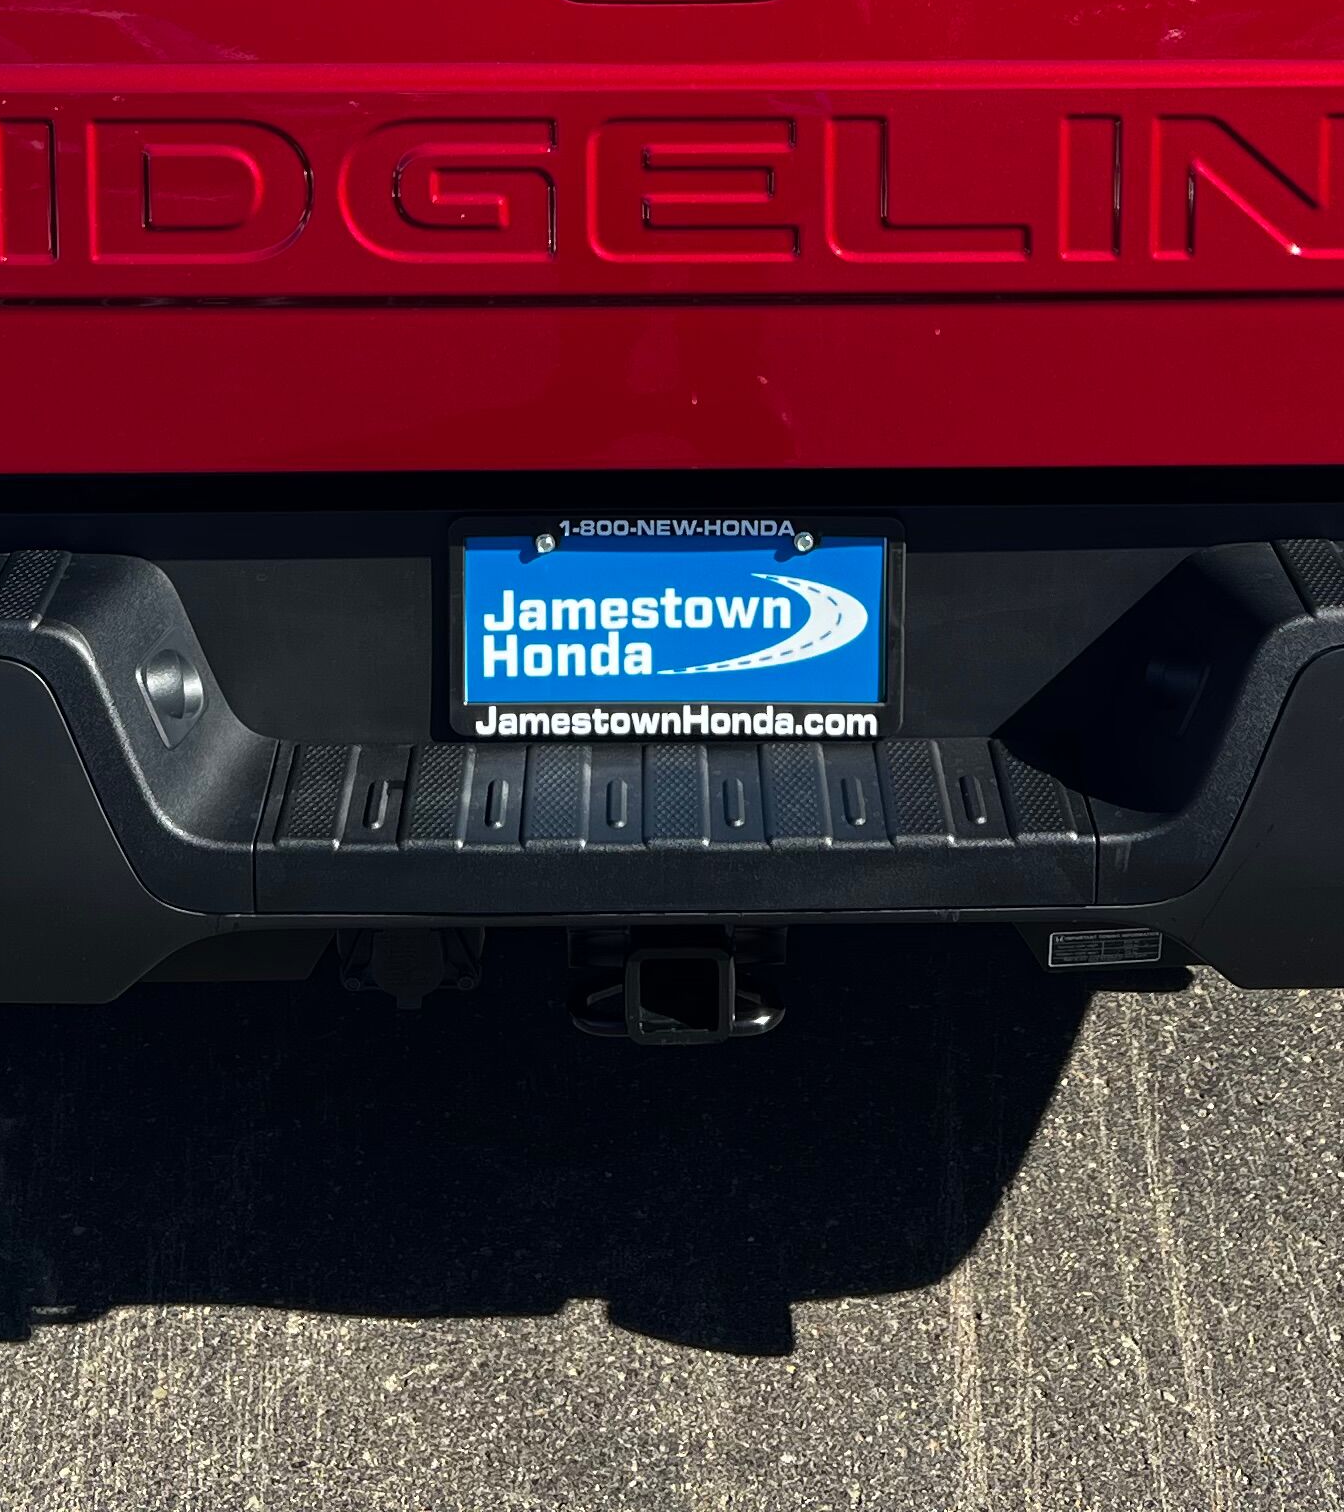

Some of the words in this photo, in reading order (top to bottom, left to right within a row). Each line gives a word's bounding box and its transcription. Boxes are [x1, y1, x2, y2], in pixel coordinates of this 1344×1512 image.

[559, 519, 796, 537] 1-800-NEW-HONDA
[483, 587, 791, 632] Jamestown
[483, 632, 653, 678] Honda
[474, 705, 878, 737] JamestownHonda.com
